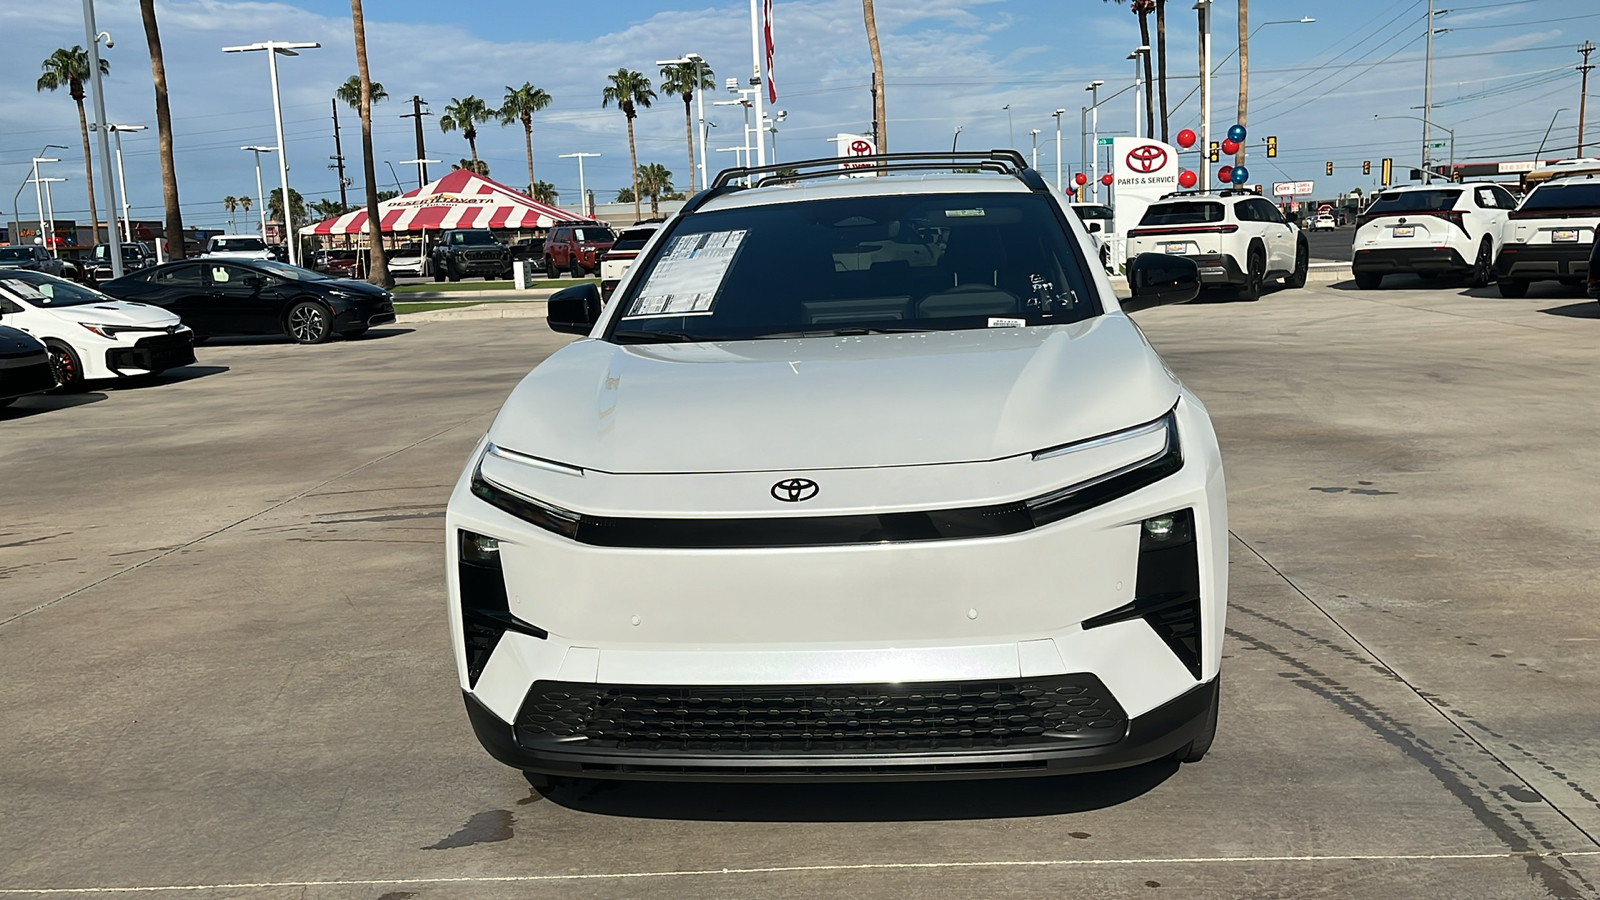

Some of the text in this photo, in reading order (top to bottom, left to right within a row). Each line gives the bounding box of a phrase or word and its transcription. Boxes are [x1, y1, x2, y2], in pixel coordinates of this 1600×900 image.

[1117, 177, 1139, 185] PARTS
[1147, 175, 1175, 183] SERVICE
[387, 198, 435, 207] DESERT
